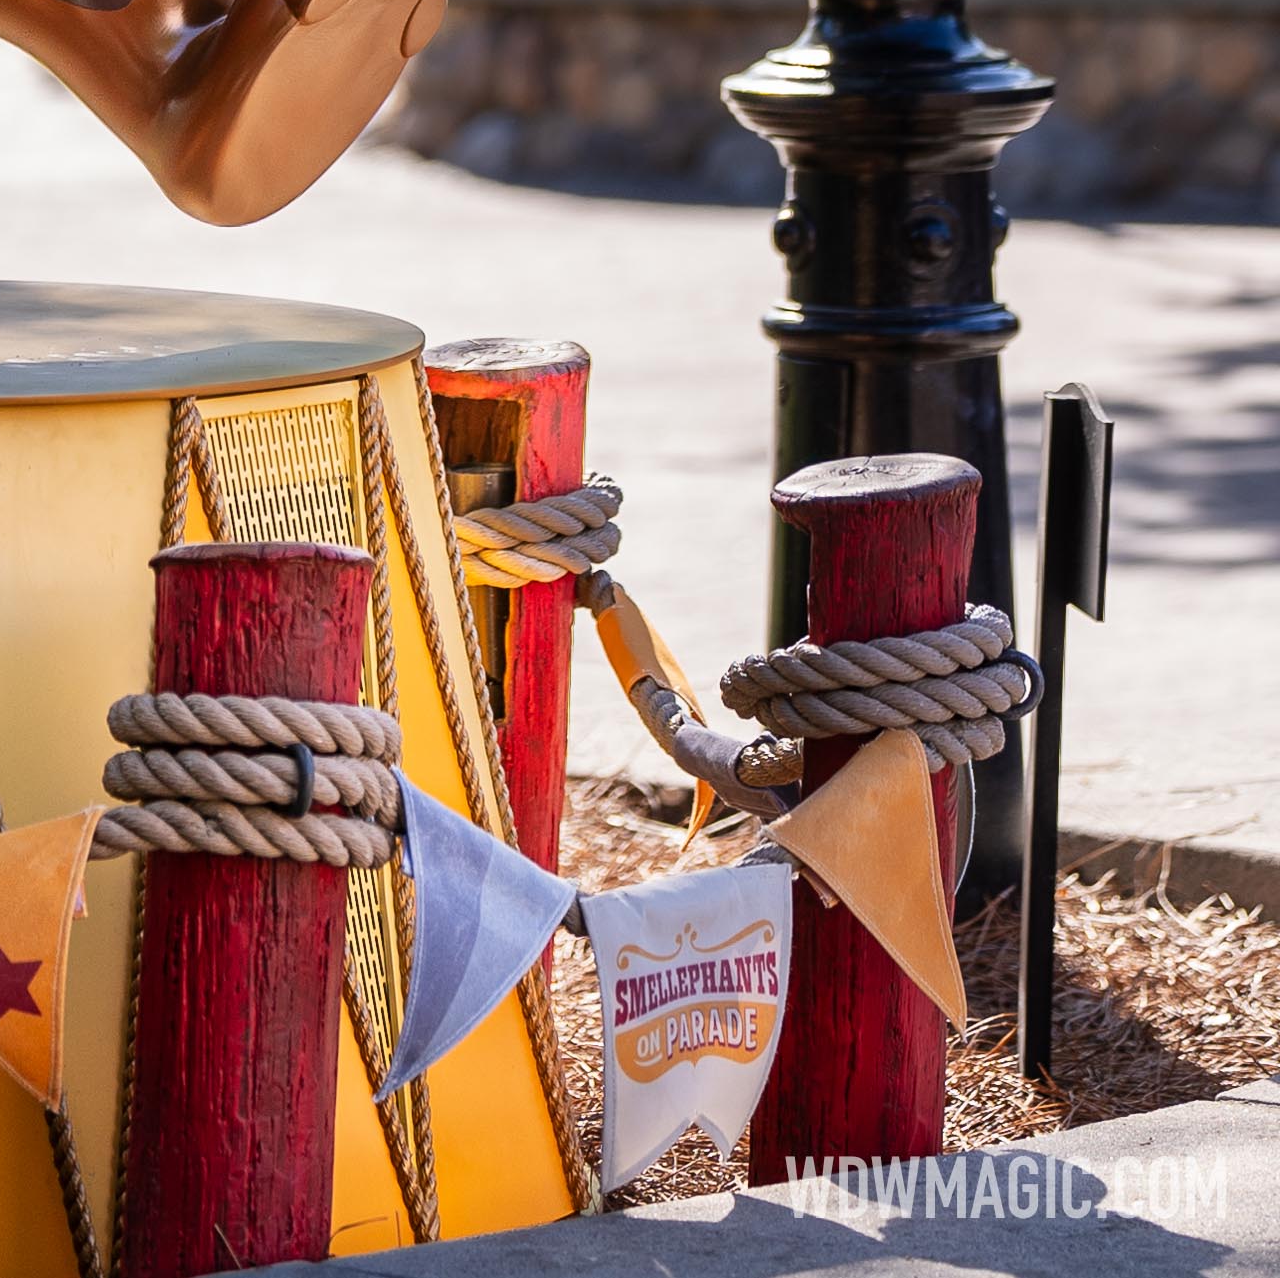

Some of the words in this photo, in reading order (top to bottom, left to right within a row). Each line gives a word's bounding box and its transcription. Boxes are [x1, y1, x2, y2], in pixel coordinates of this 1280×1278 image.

[614, 951, 778, 1027] SMELLEPHANTS
[637, 1031, 661, 1058] ON
[666, 1007, 757, 1059] PARADE
